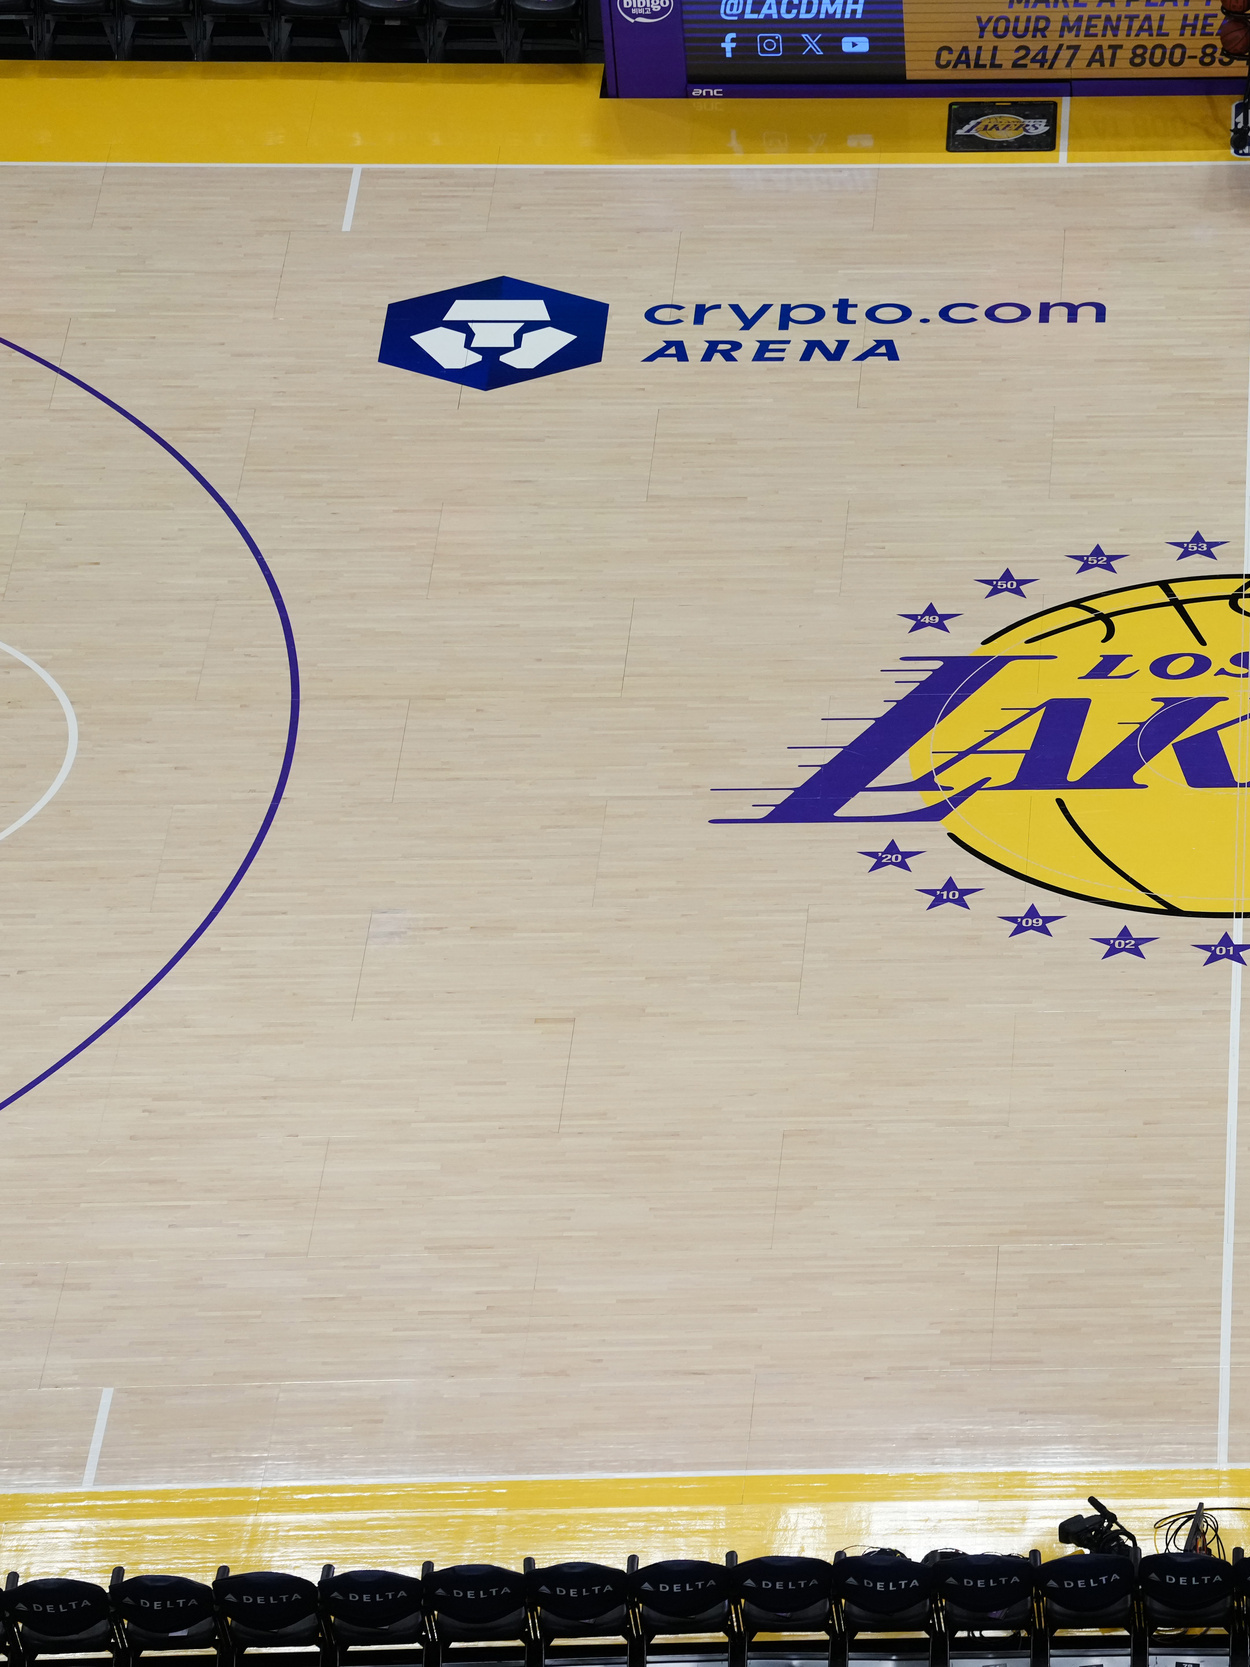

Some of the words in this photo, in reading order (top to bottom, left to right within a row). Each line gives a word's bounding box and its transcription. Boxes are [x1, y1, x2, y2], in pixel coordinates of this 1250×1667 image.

[720, 0, 864, 20] @LACDMH
[975, 15, 1051, 38] YOUR
[1058, 14, 1170, 38] MENTAL
[934, 45, 1003, 69] CALL
[1011, 43, 1081, 69] 24/7
[1086, 44, 1124, 68] AT
[692, 88, 723, 96] anc
[644, 298, 1107, 331] crypto.com
[642, 339, 900, 362] ARENA
[1182, 542, 1208, 552] '53
[1082, 556, 1108, 566] '52
[991, 579, 1018, 590] '50
[918, 615, 940, 624] '49
[877, 851, 903, 864] '20
[937, 890, 960, 900] '10
[1018, 917, 1043, 927] '09
[1108, 939, 1136, 950] '02
[1211, 944, 1234, 956] '01
[659, 1579, 716, 1593] DELTA
[761, 1579, 818, 1590] DELTA
[863, 1579, 919, 1591] DELTA
[963, 1576, 1020, 1588] DELTA
[1063, 1573, 1120, 1588] DELTA
[1165, 1574, 1223, 1586] DELTA
[348, 1590, 408, 1602] DELTA
[453, 1586, 511, 1599] DELTA
[556, 1584, 614, 1598] DELTA
[140, 1598, 198, 1610] DELTA
[242, 1593, 302, 1604] DELTA
[32, 1599, 92, 1613] DELTA
